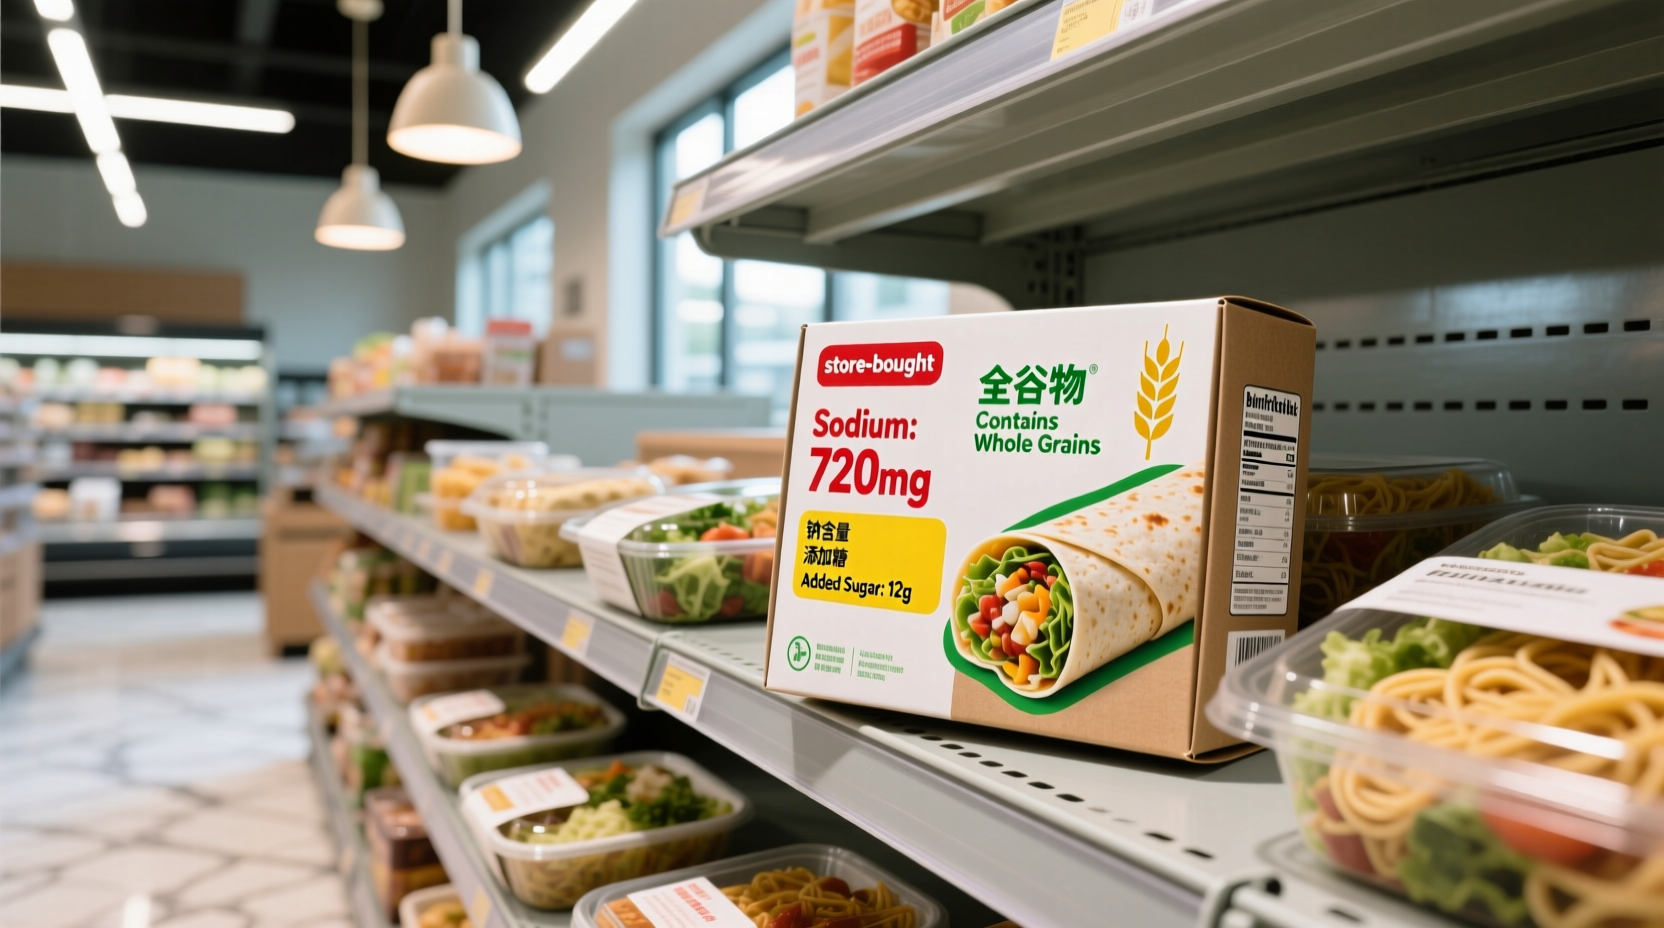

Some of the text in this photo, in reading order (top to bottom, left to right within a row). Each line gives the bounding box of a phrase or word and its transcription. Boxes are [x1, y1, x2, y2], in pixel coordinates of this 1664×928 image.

[824, 353, 936, 378] store-bought
[978, 363, 1087, 406] 全谷物
[812, 408, 918, 441] Sodium:
[975, 410, 1059, 431] Contains
[974, 432, 1102, 455] Whole Grains
[808, 447, 932, 509] 720mg
[800, 572, 913, 605] Added Sugar: 12g
